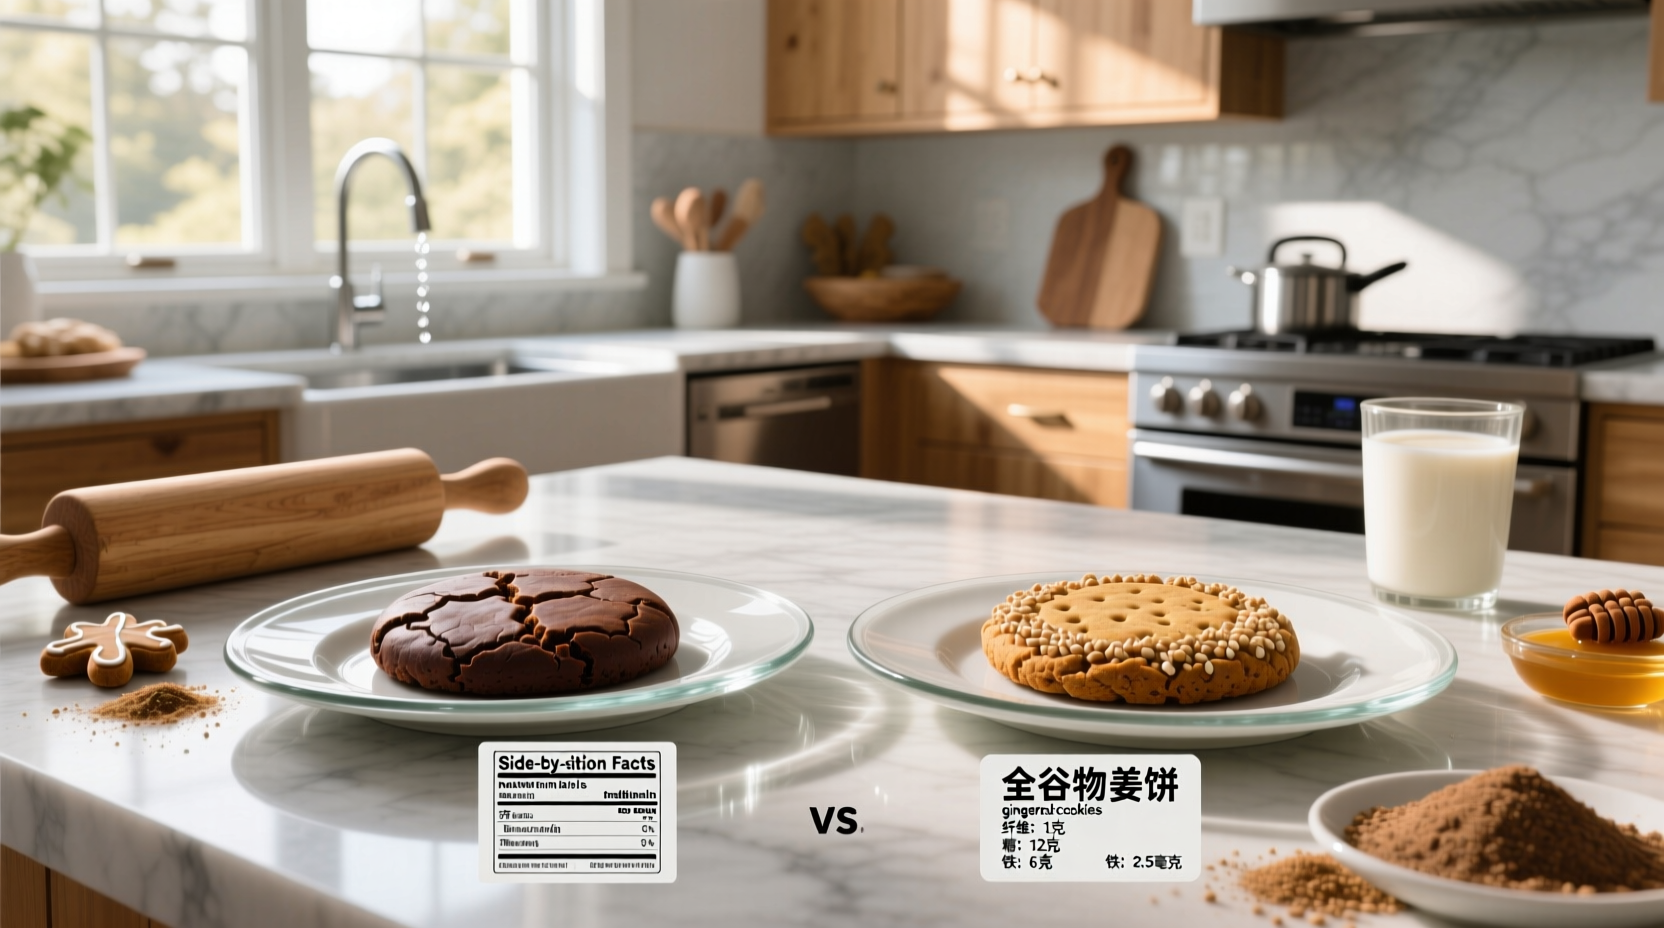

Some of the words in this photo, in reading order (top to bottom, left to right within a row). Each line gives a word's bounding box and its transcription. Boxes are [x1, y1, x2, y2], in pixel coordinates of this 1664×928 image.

[612, 755, 656, 771] Facts
[1001, 765, 1179, 803] 全谷物姜饼
